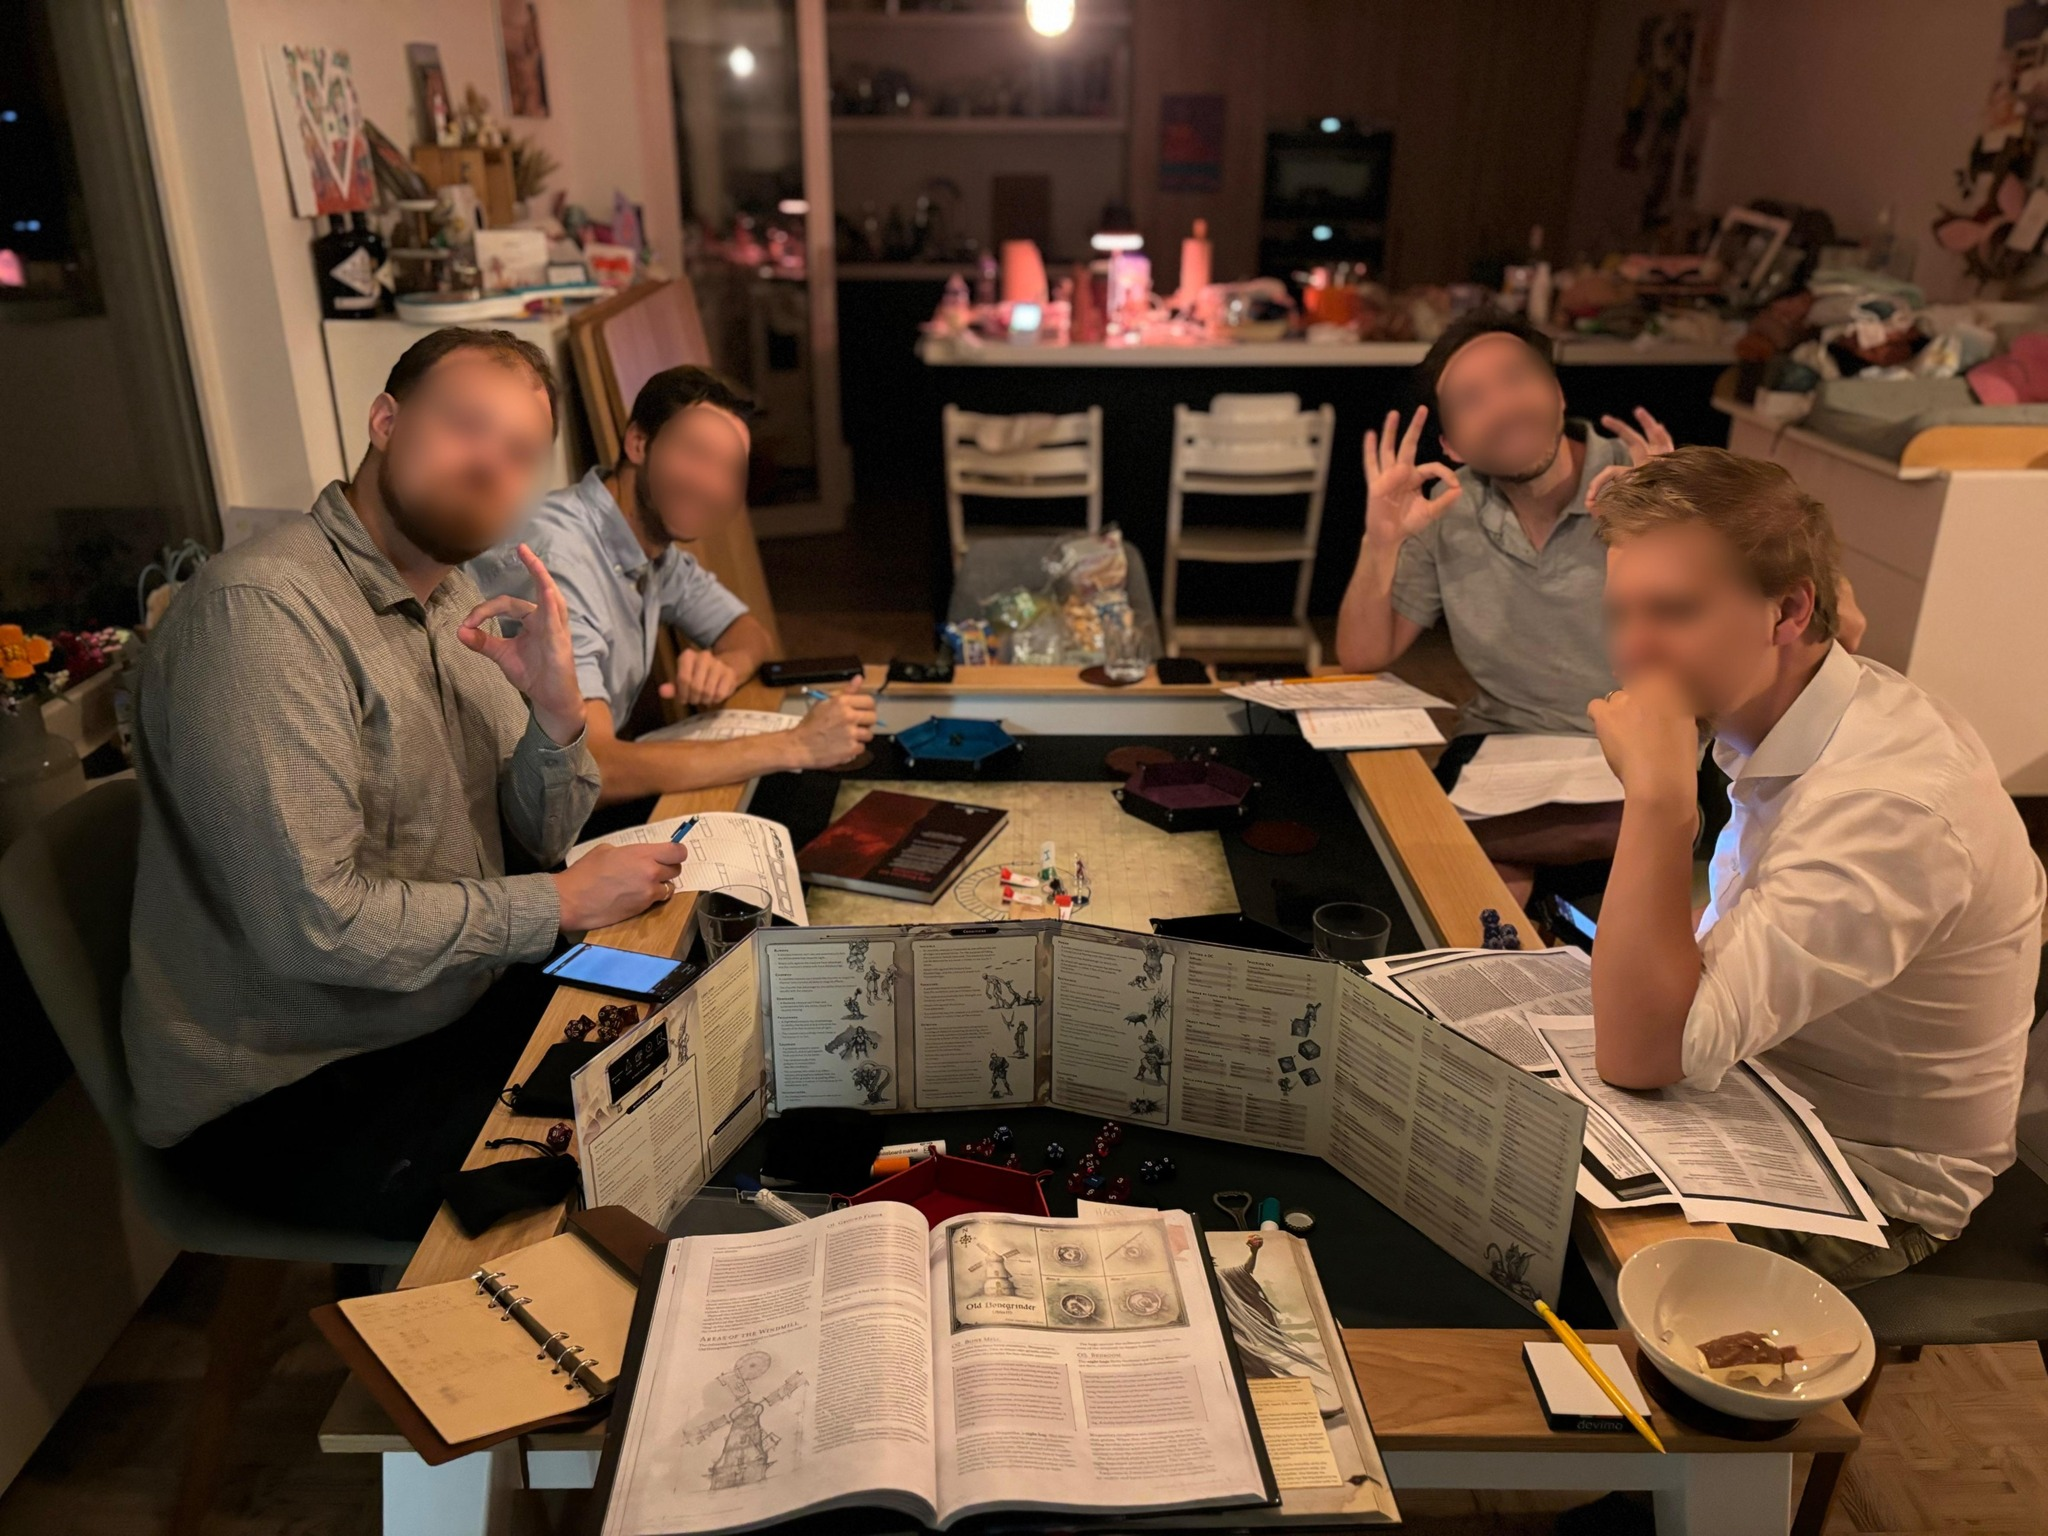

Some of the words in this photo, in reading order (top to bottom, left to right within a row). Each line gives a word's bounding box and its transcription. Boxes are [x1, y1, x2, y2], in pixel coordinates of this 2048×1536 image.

[966, 1302, 982, 1311] Old
[759, 1321, 800, 1334] WINDMILL
[1577, 1421, 1624, 1431] devimo
